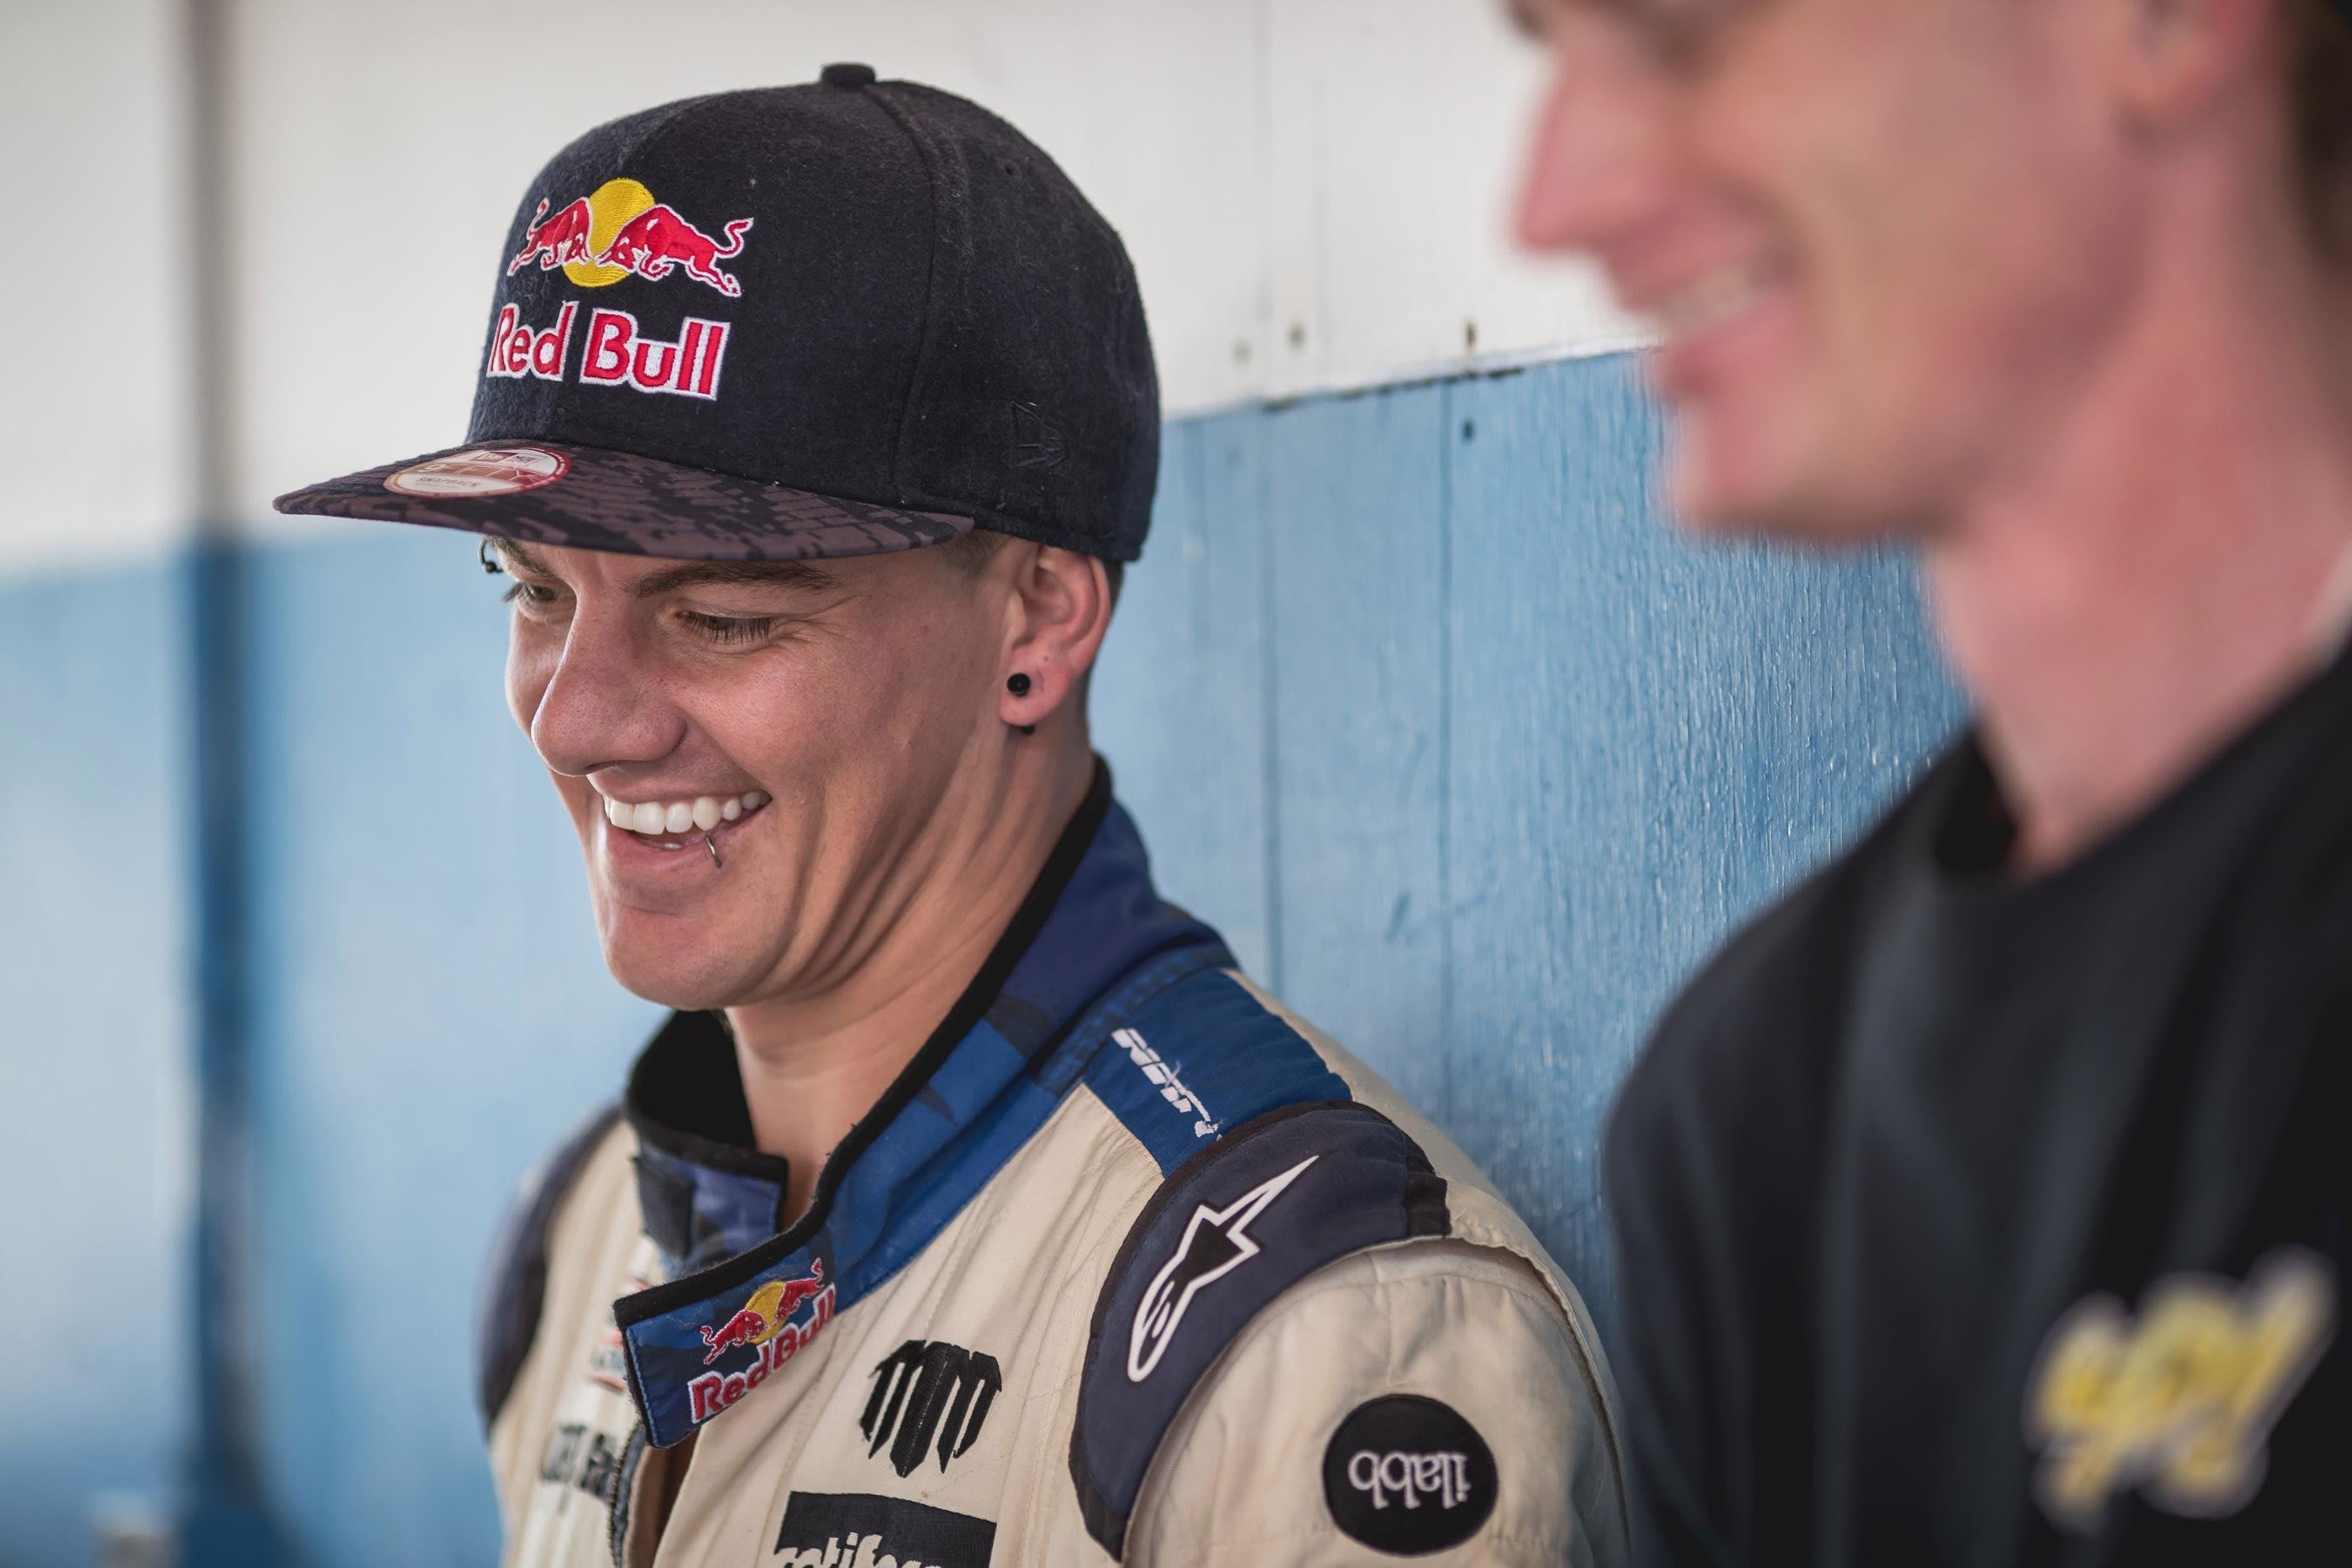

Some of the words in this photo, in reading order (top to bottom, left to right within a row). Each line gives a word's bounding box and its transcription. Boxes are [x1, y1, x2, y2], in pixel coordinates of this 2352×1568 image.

[486, 301, 580, 381] Red
[579, 307, 731, 401] Bull
[688, 1340, 772, 1424] Red
[772, 1282, 837, 1371] Bull
[1347, 1450, 1472, 1509] ilabb
